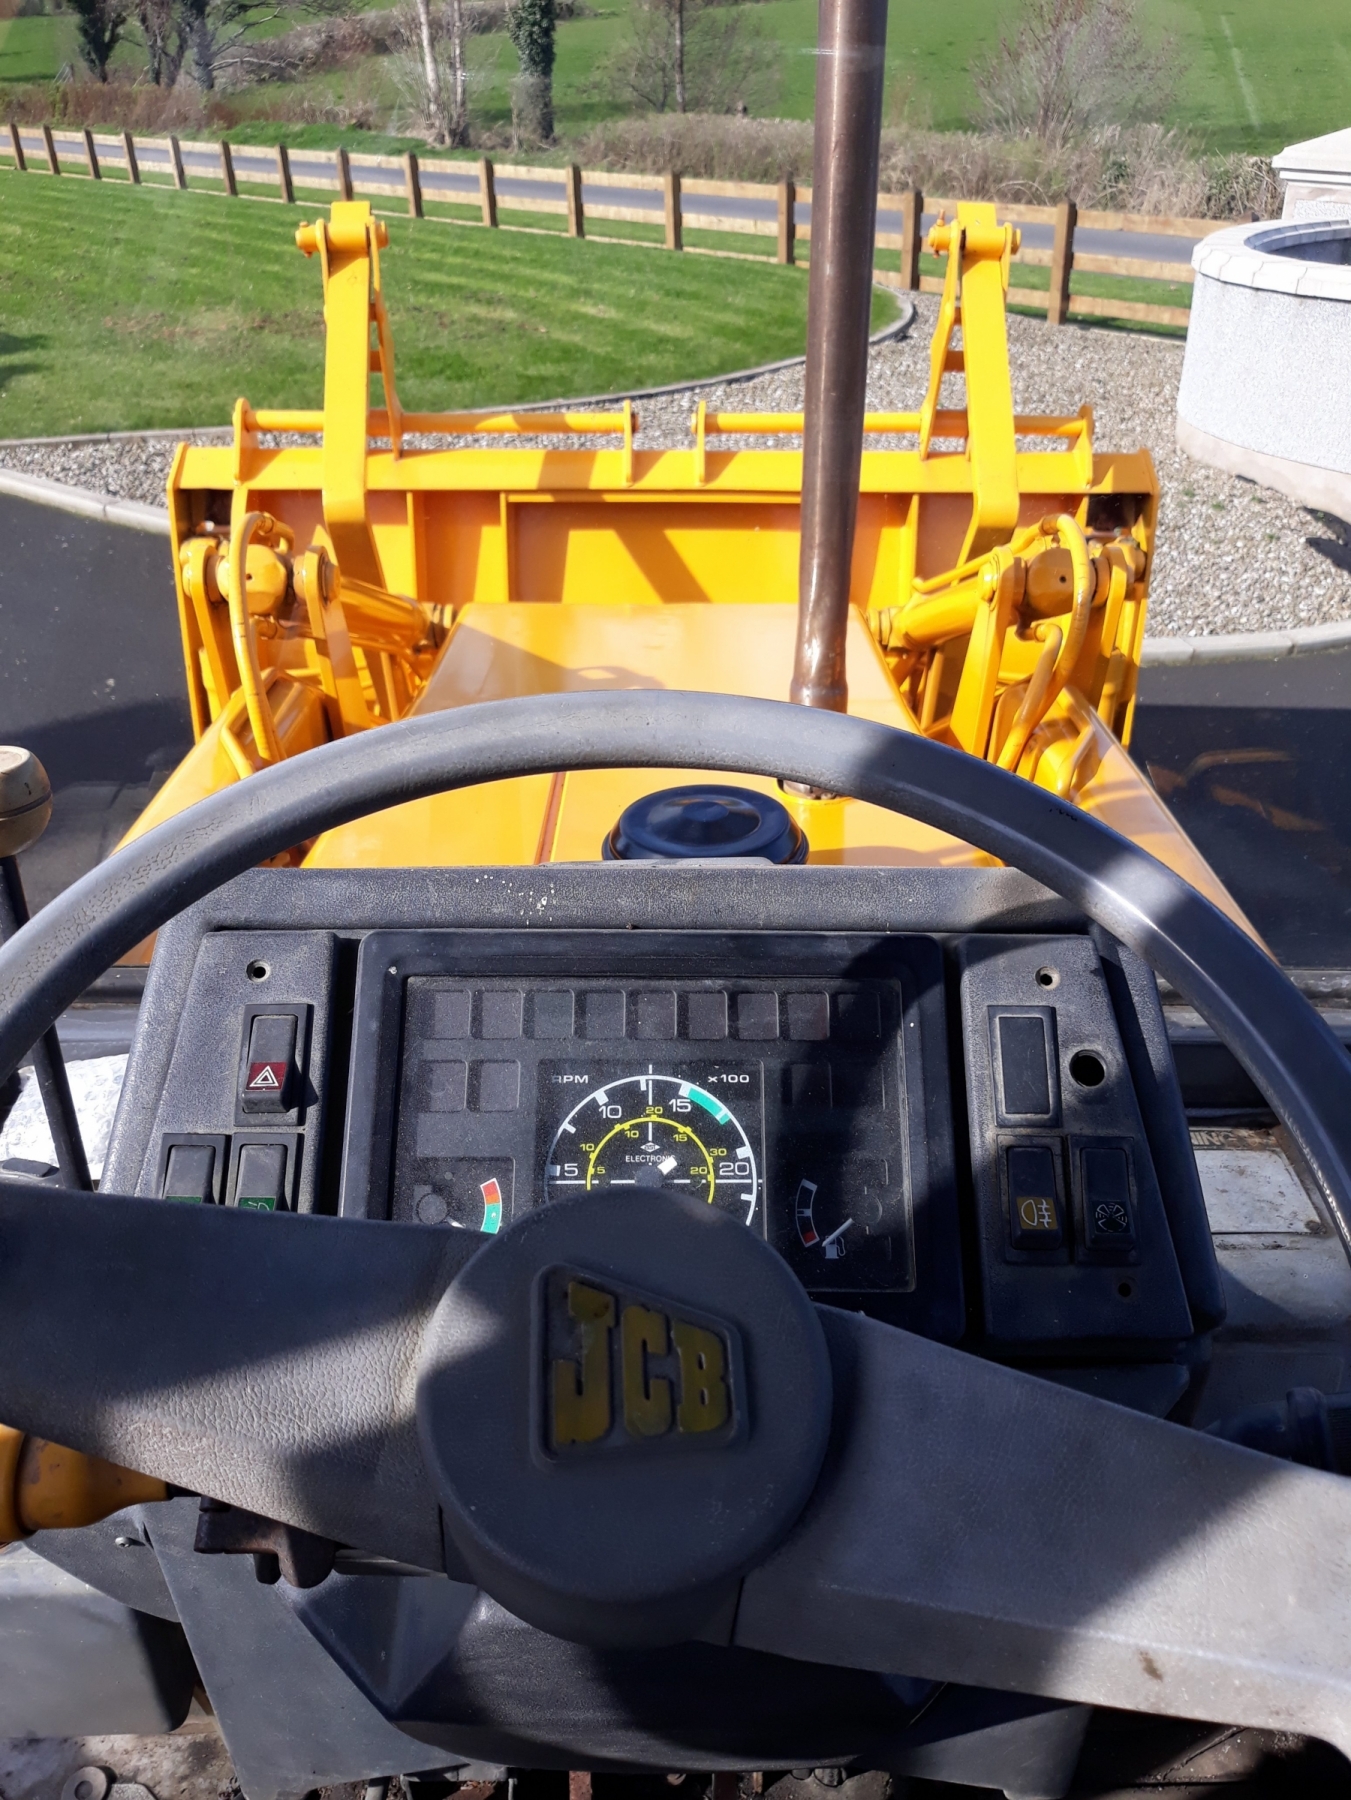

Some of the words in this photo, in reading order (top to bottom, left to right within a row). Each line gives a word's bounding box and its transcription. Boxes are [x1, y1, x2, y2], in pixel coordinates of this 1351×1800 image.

[552, 1074, 589, 1084] RPM
[668, 1098, 692, 1113] 15
[598, 1105, 622, 1119] 10
[645, 1106, 663, 1114] 20
[624, 1130, 639, 1138] 10
[673, 1134, 688, 1142] 15
[580, 1143, 595, 1151] 10
[709, 1148, 727, 1156] 30
[564, 1163, 579, 1176] 5
[596, 1166, 606, 1174] 5
[690, 1166, 708, 1174] 20
[719, 1161, 750, 1176] 20
[553, 1280, 728, 1446] JCB
